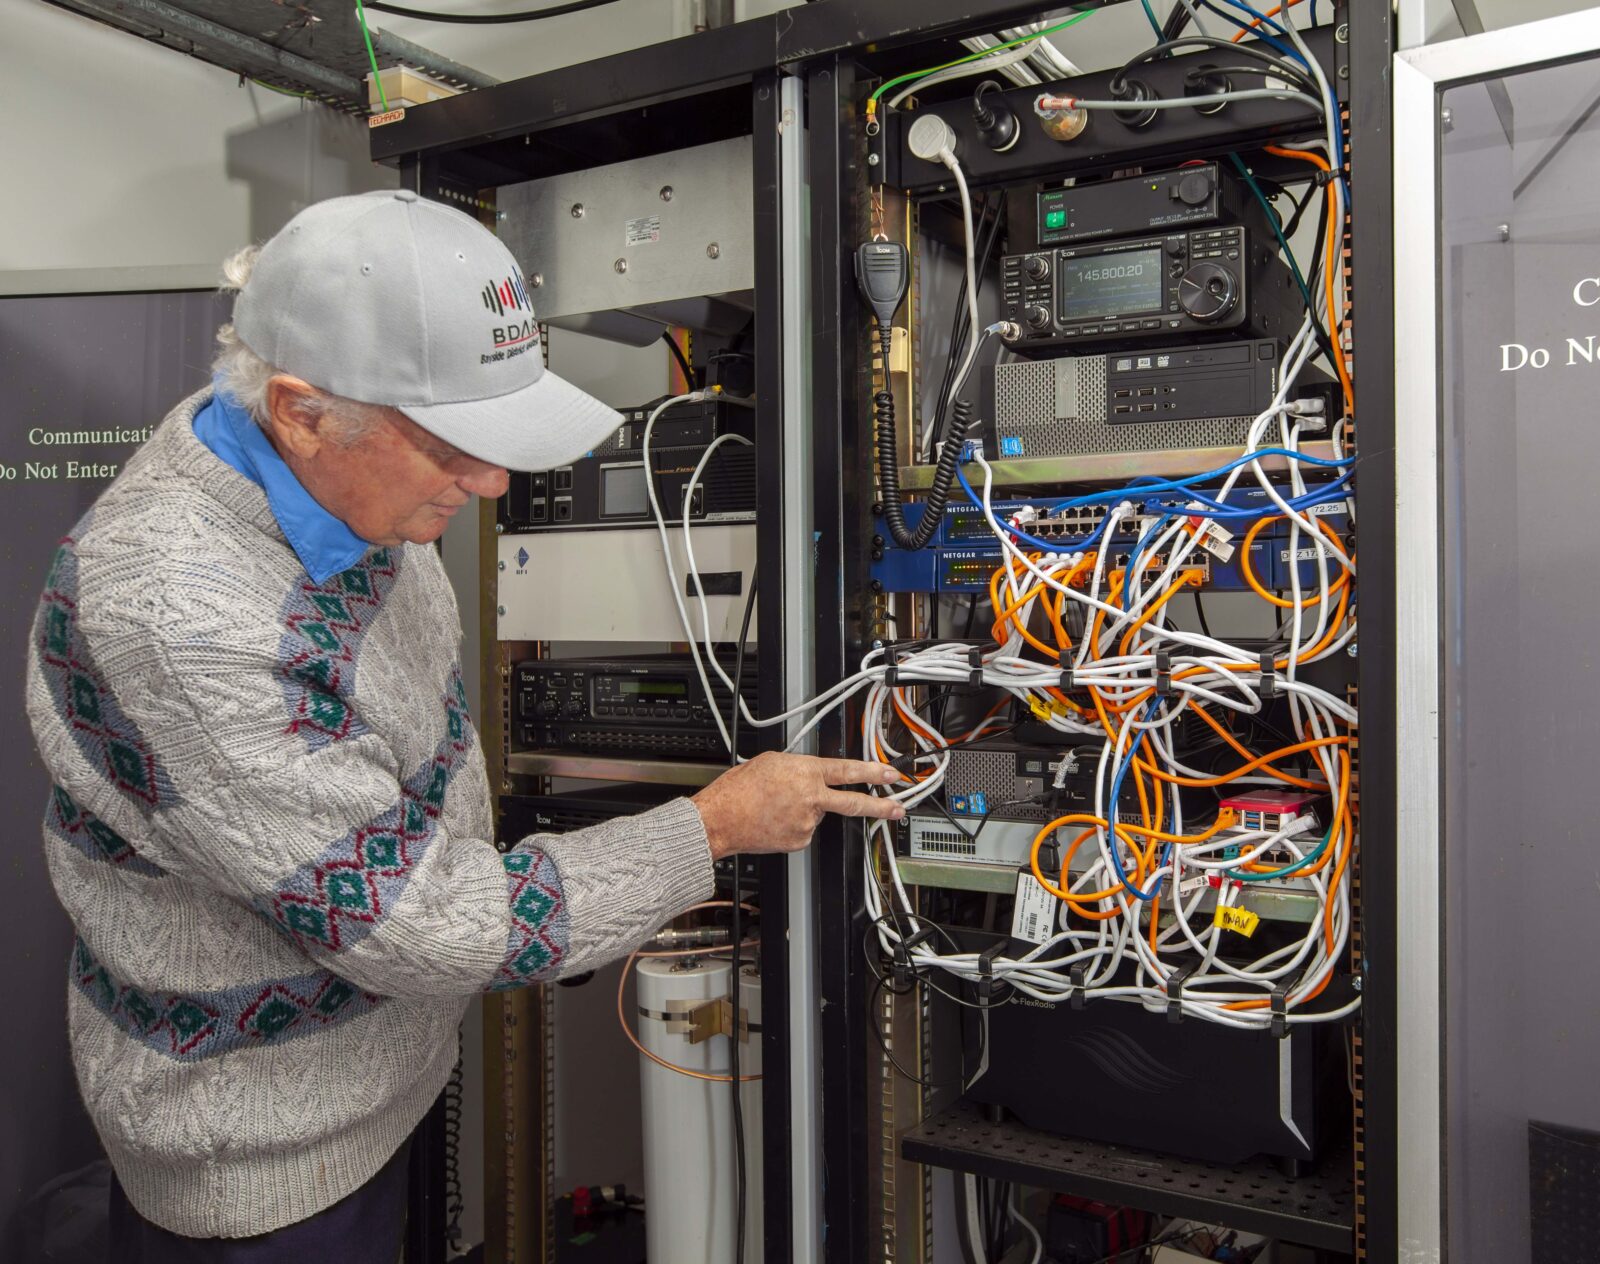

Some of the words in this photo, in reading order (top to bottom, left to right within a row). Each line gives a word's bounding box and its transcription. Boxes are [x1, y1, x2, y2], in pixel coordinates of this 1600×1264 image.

[1077, 264, 1143, 283] 145.800.20
[1500, 343, 1550, 371] Do
[1566, 335, 1600, 365] N
[25, 462, 58, 479] Not
[66, 461, 117, 478] Enter
[943, 551, 976, 559] NETGEAR
[1282, 551, 1302, 559] DZ
[1019, 997, 1056, 1009] FlexRadio
